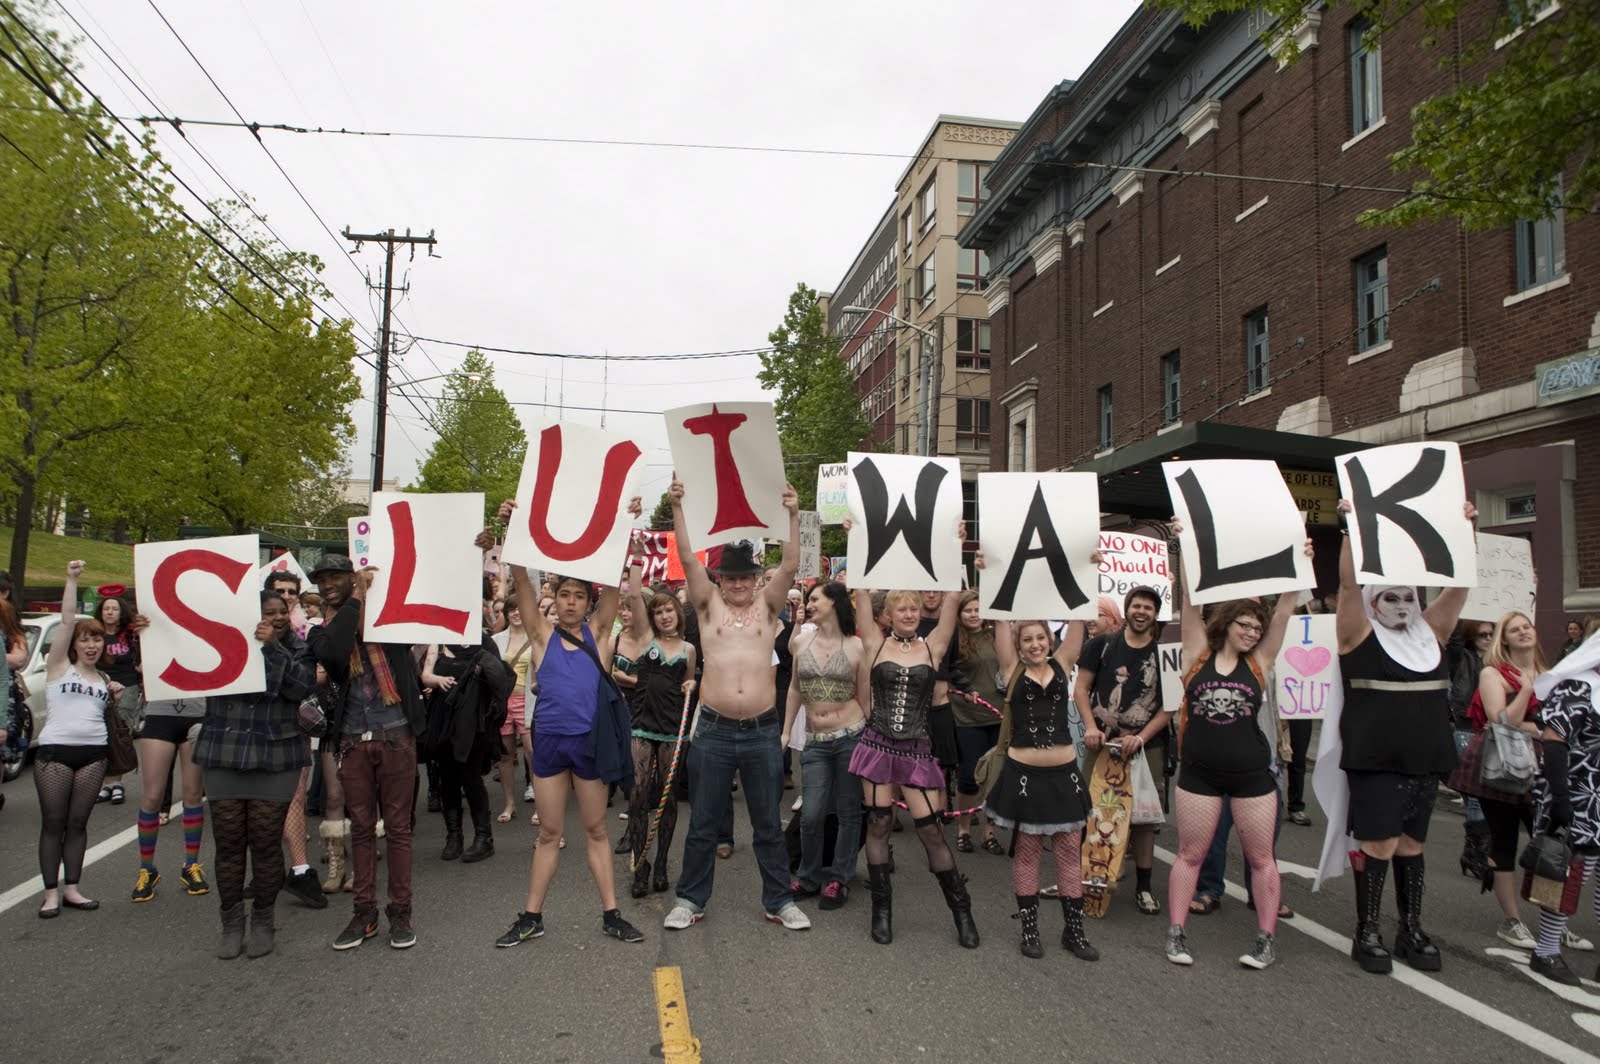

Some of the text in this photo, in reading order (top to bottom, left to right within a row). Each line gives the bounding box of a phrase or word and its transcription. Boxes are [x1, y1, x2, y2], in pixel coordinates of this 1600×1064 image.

[529, 424, 642, 561] U
[852, 457, 948, 581] W
[1175, 468, 1297, 593] L
[1295, 473, 1308, 485] OF
[1311, 475, 1334, 487] LIFE
[1345, 447, 1455, 578] K
[373, 501, 470, 636] L
[989, 481, 1090, 612] A
[1098, 535, 1167, 557] NO ONE
[154, 549, 253, 691] S
[1300, 616, 1313, 644] I
